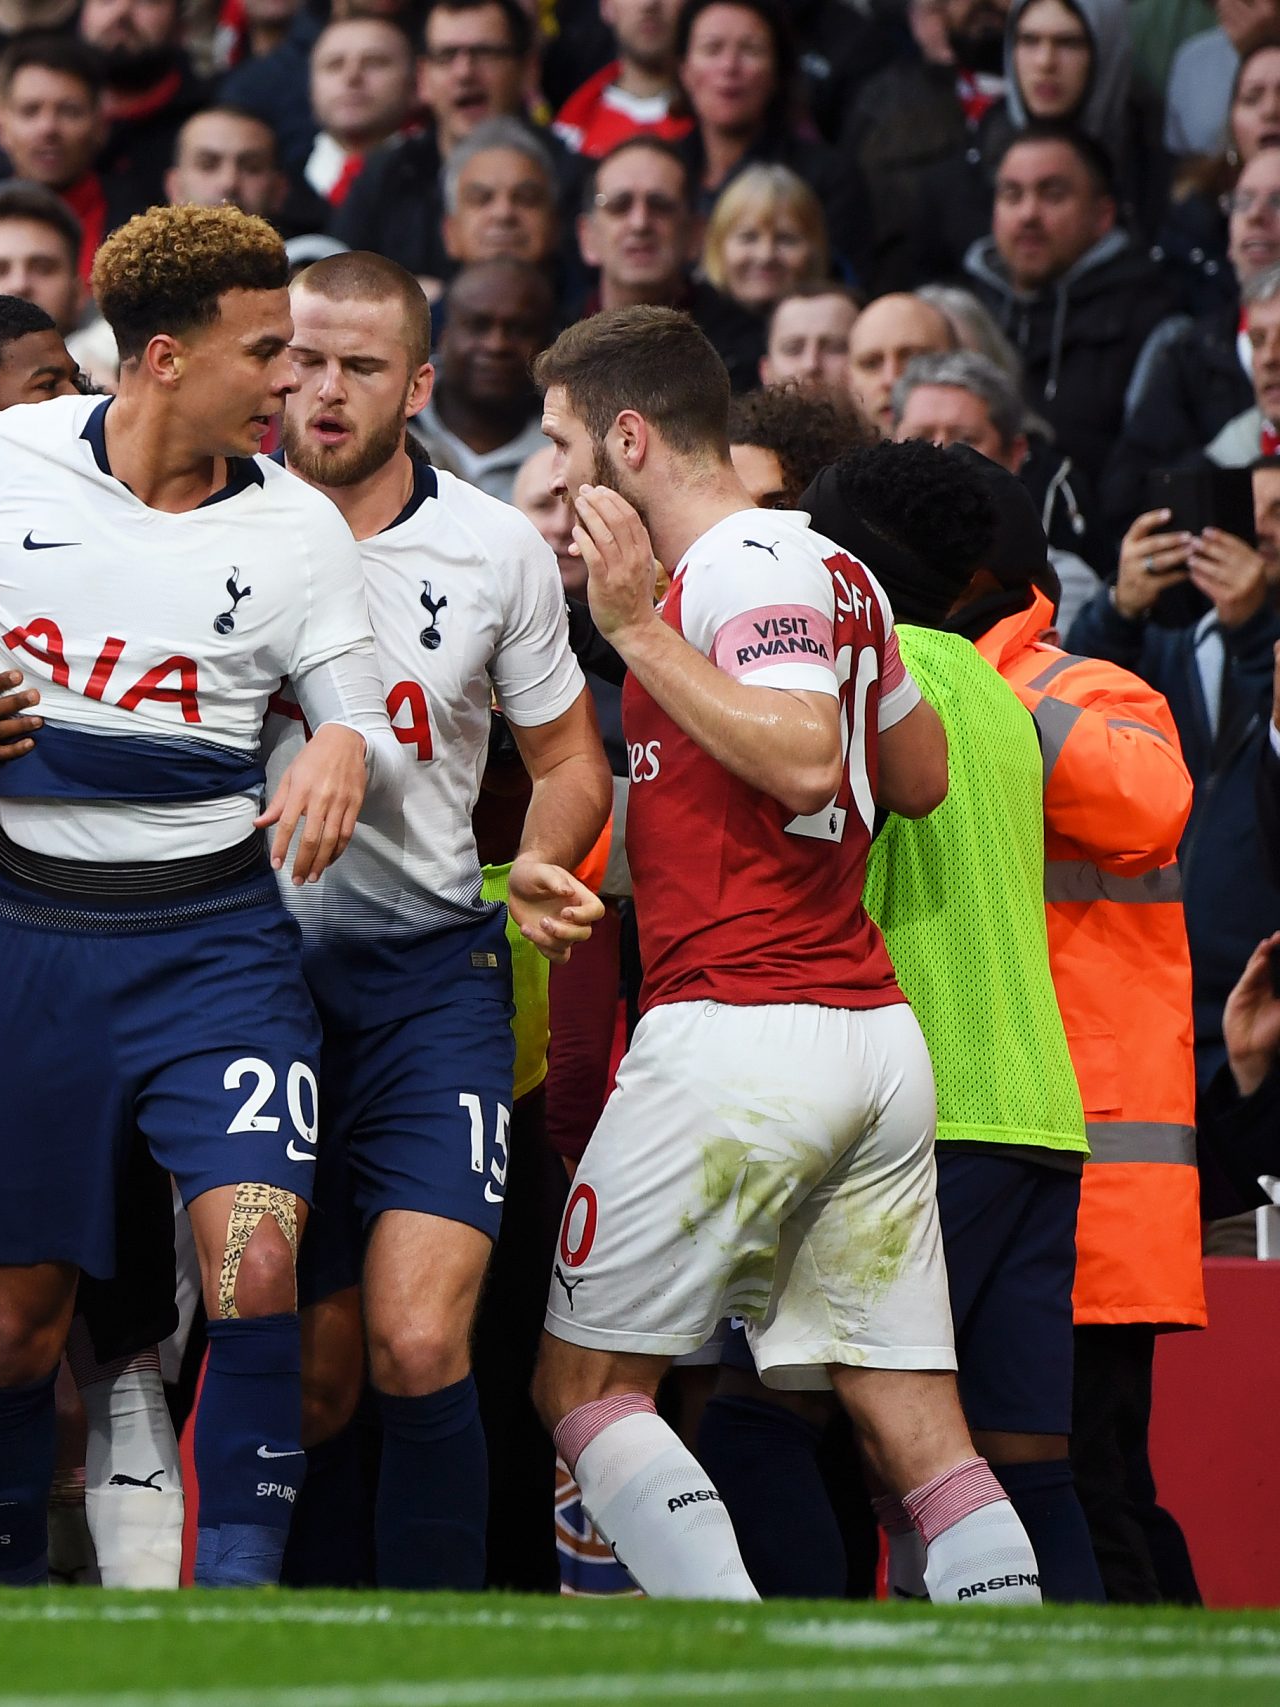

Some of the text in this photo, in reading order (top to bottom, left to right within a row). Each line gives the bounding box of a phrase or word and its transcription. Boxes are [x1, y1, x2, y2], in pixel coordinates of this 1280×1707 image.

[753, 617, 808, 639] VISIT
[736, 637, 829, 666] RWANDA
[223, 1057, 319, 1144] 20
[458, 1092, 511, 1186] 15
[255, 1482, 297, 1503] SPURS
